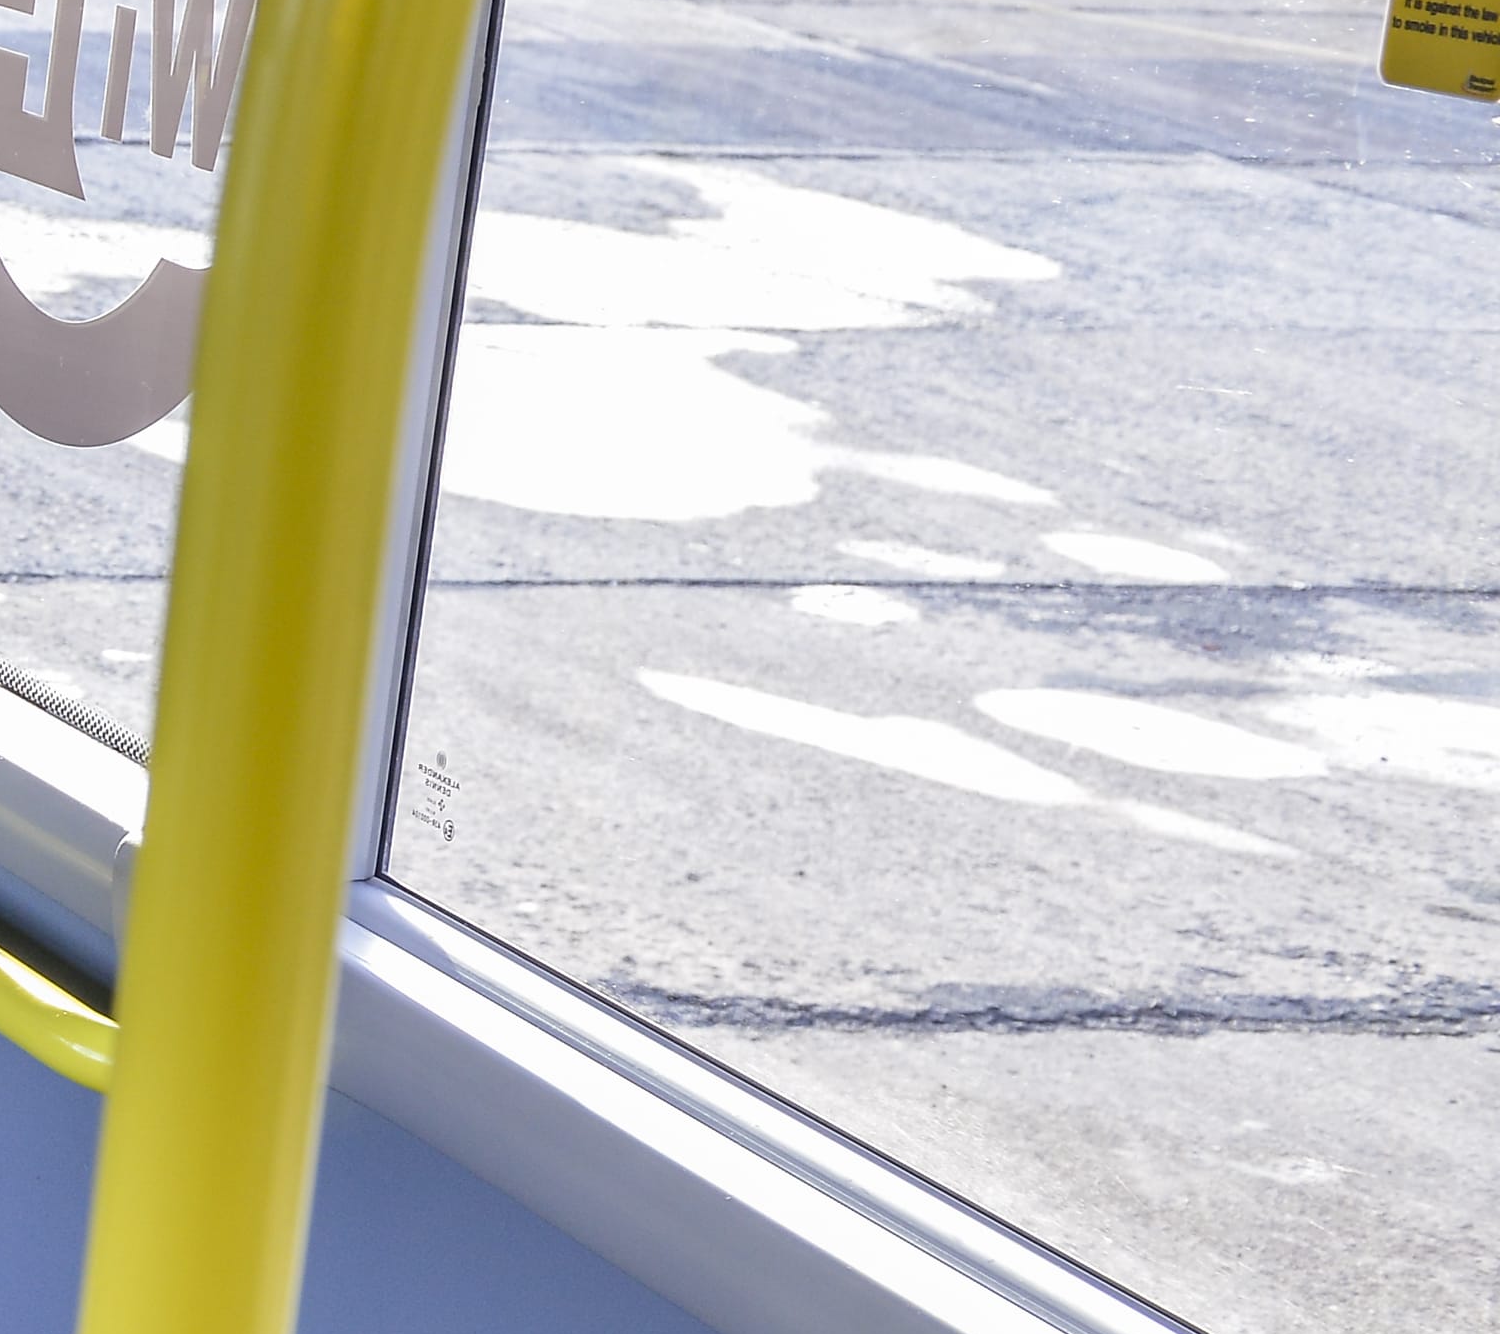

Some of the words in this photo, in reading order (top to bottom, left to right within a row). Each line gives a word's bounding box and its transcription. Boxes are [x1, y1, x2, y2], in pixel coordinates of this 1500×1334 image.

[1425, 0, 1462, 16] against
[1464, 3, 1481, 20] the
[1392, 15, 1403, 29] to
[1451, 24, 1470, 42] this
